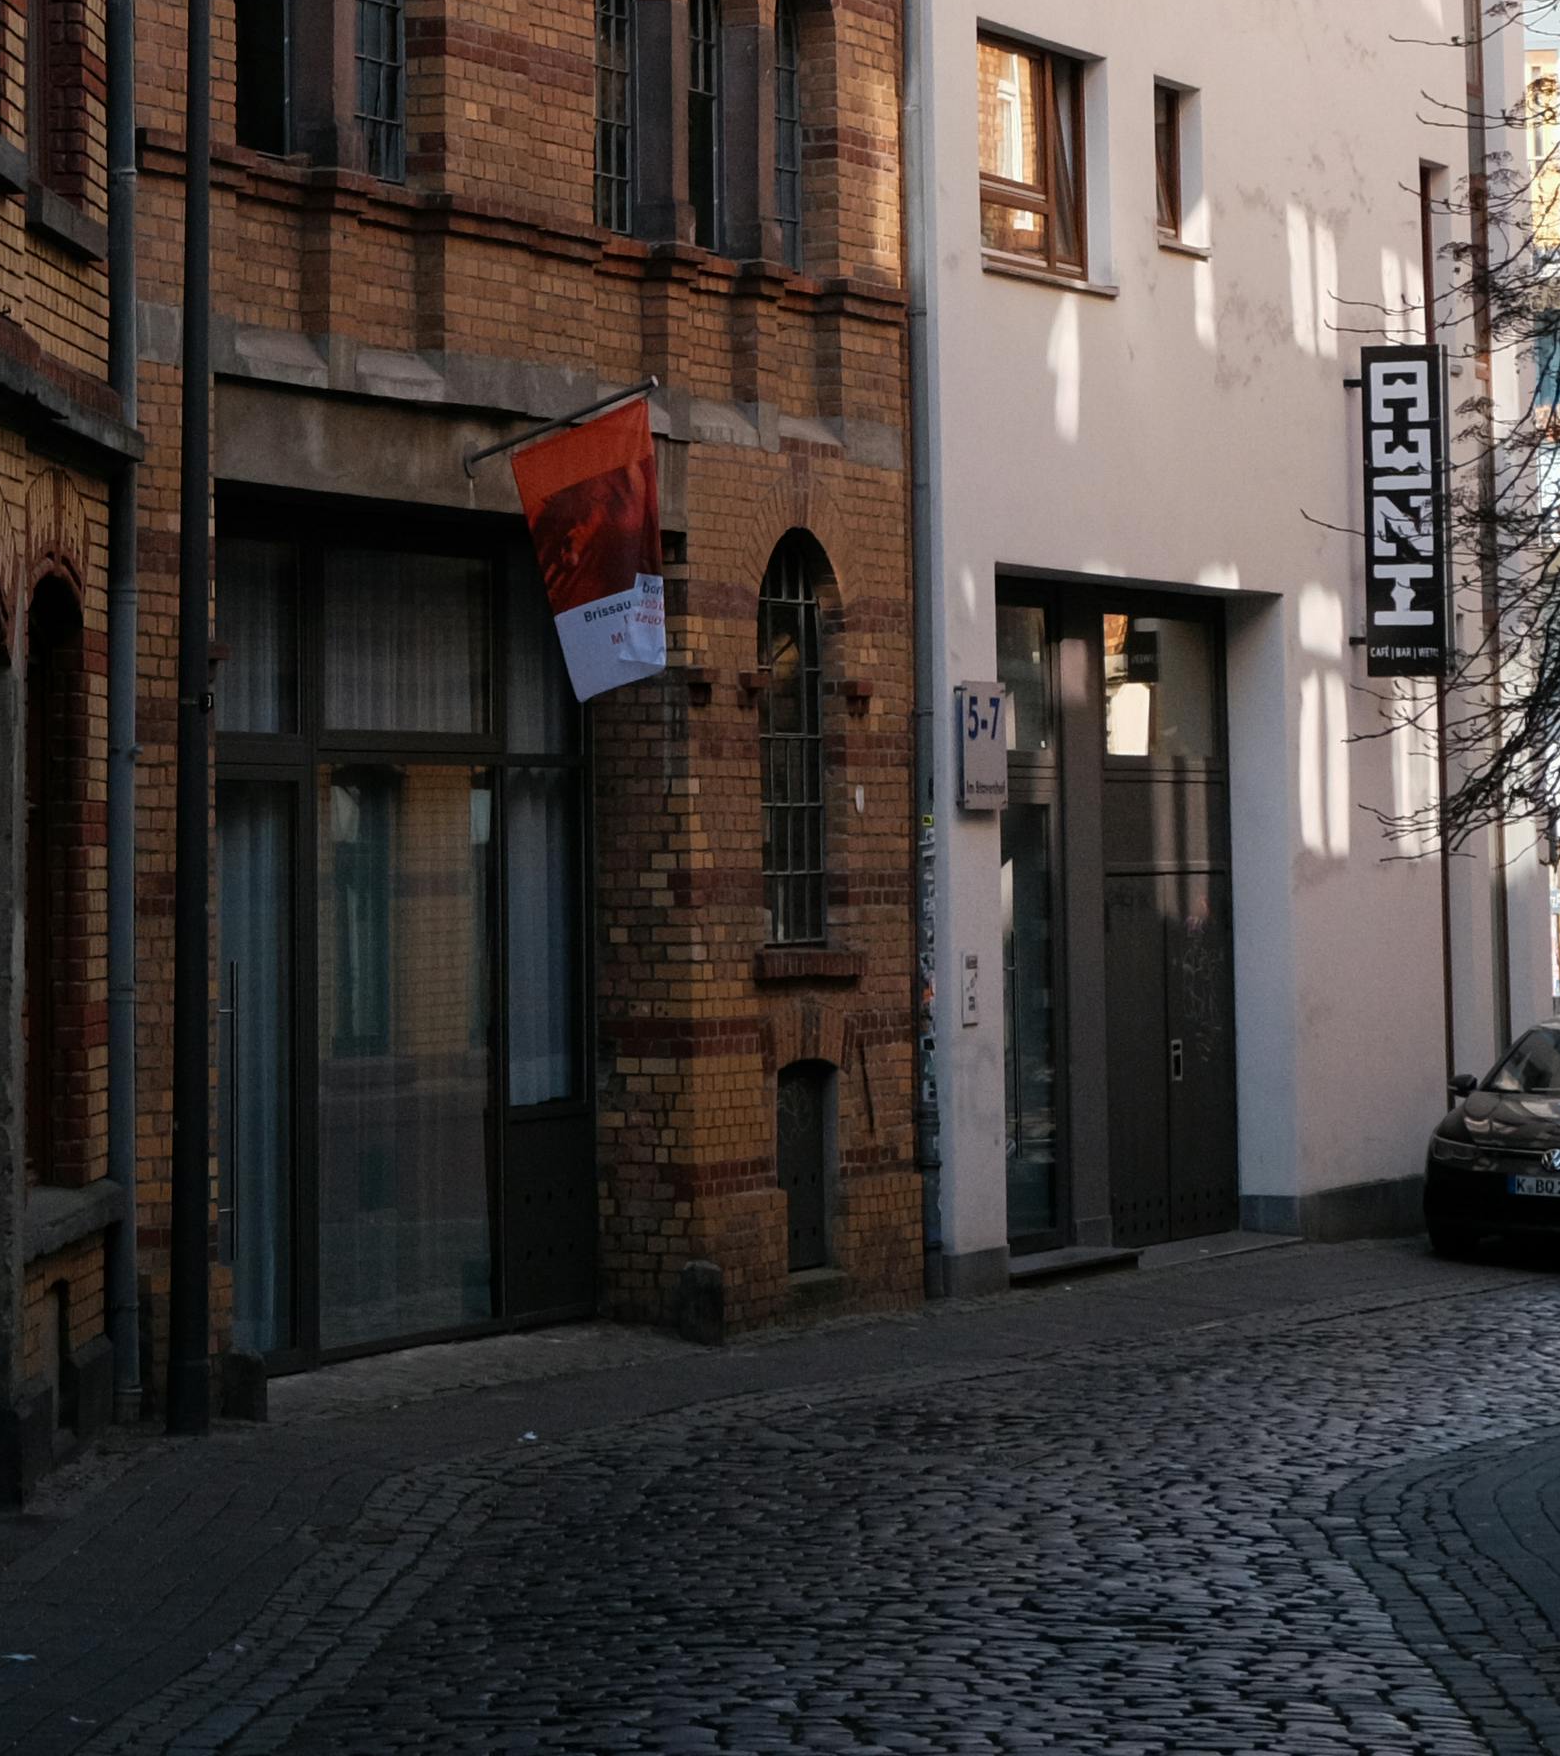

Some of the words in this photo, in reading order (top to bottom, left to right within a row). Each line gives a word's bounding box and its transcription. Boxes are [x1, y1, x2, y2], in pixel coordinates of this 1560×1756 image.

[1370, 645, 1389, 657] CAFÉ
[1396, 647, 1411, 657] BAR
[969, 696, 1000, 740] 5-7
[1516, 1179, 1526, 1192] K
